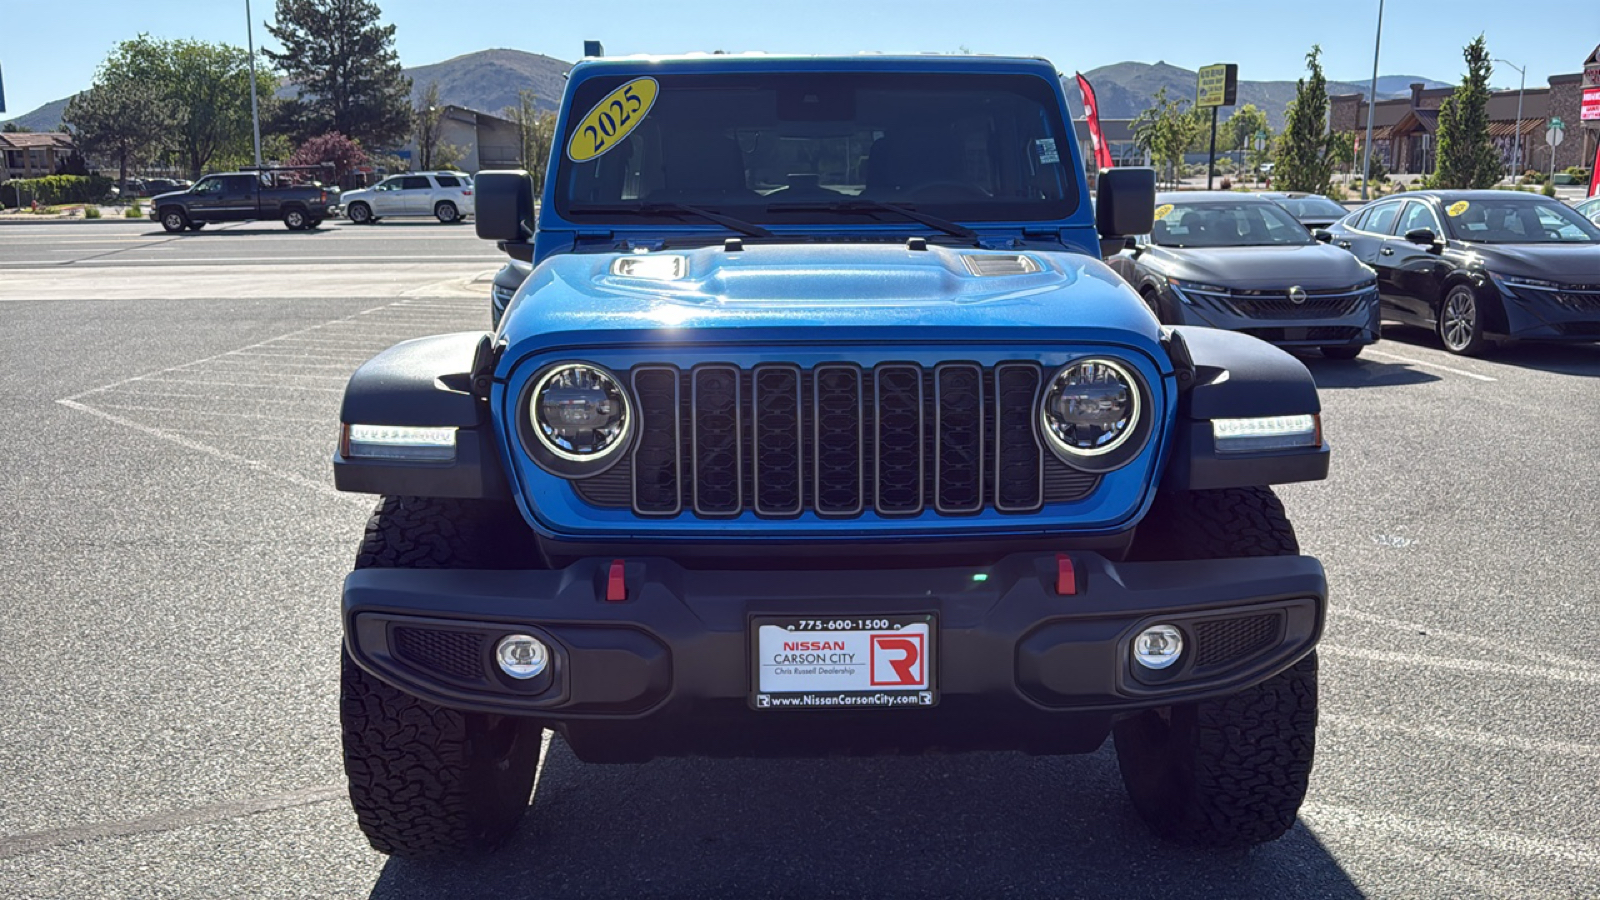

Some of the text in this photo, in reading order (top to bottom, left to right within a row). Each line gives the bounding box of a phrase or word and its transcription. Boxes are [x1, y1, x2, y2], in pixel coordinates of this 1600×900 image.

[584, 85, 642, 153] 2025
[799, 619, 889, 630] 775-600-1500
[784, 641, 845, 651] NISSAN
[774, 653, 856, 664] CARSON CITY
[774, 667, 855, 676] Chris Russell Dealership
[771, 693, 918, 706] www.NissanCarsonCity.com
